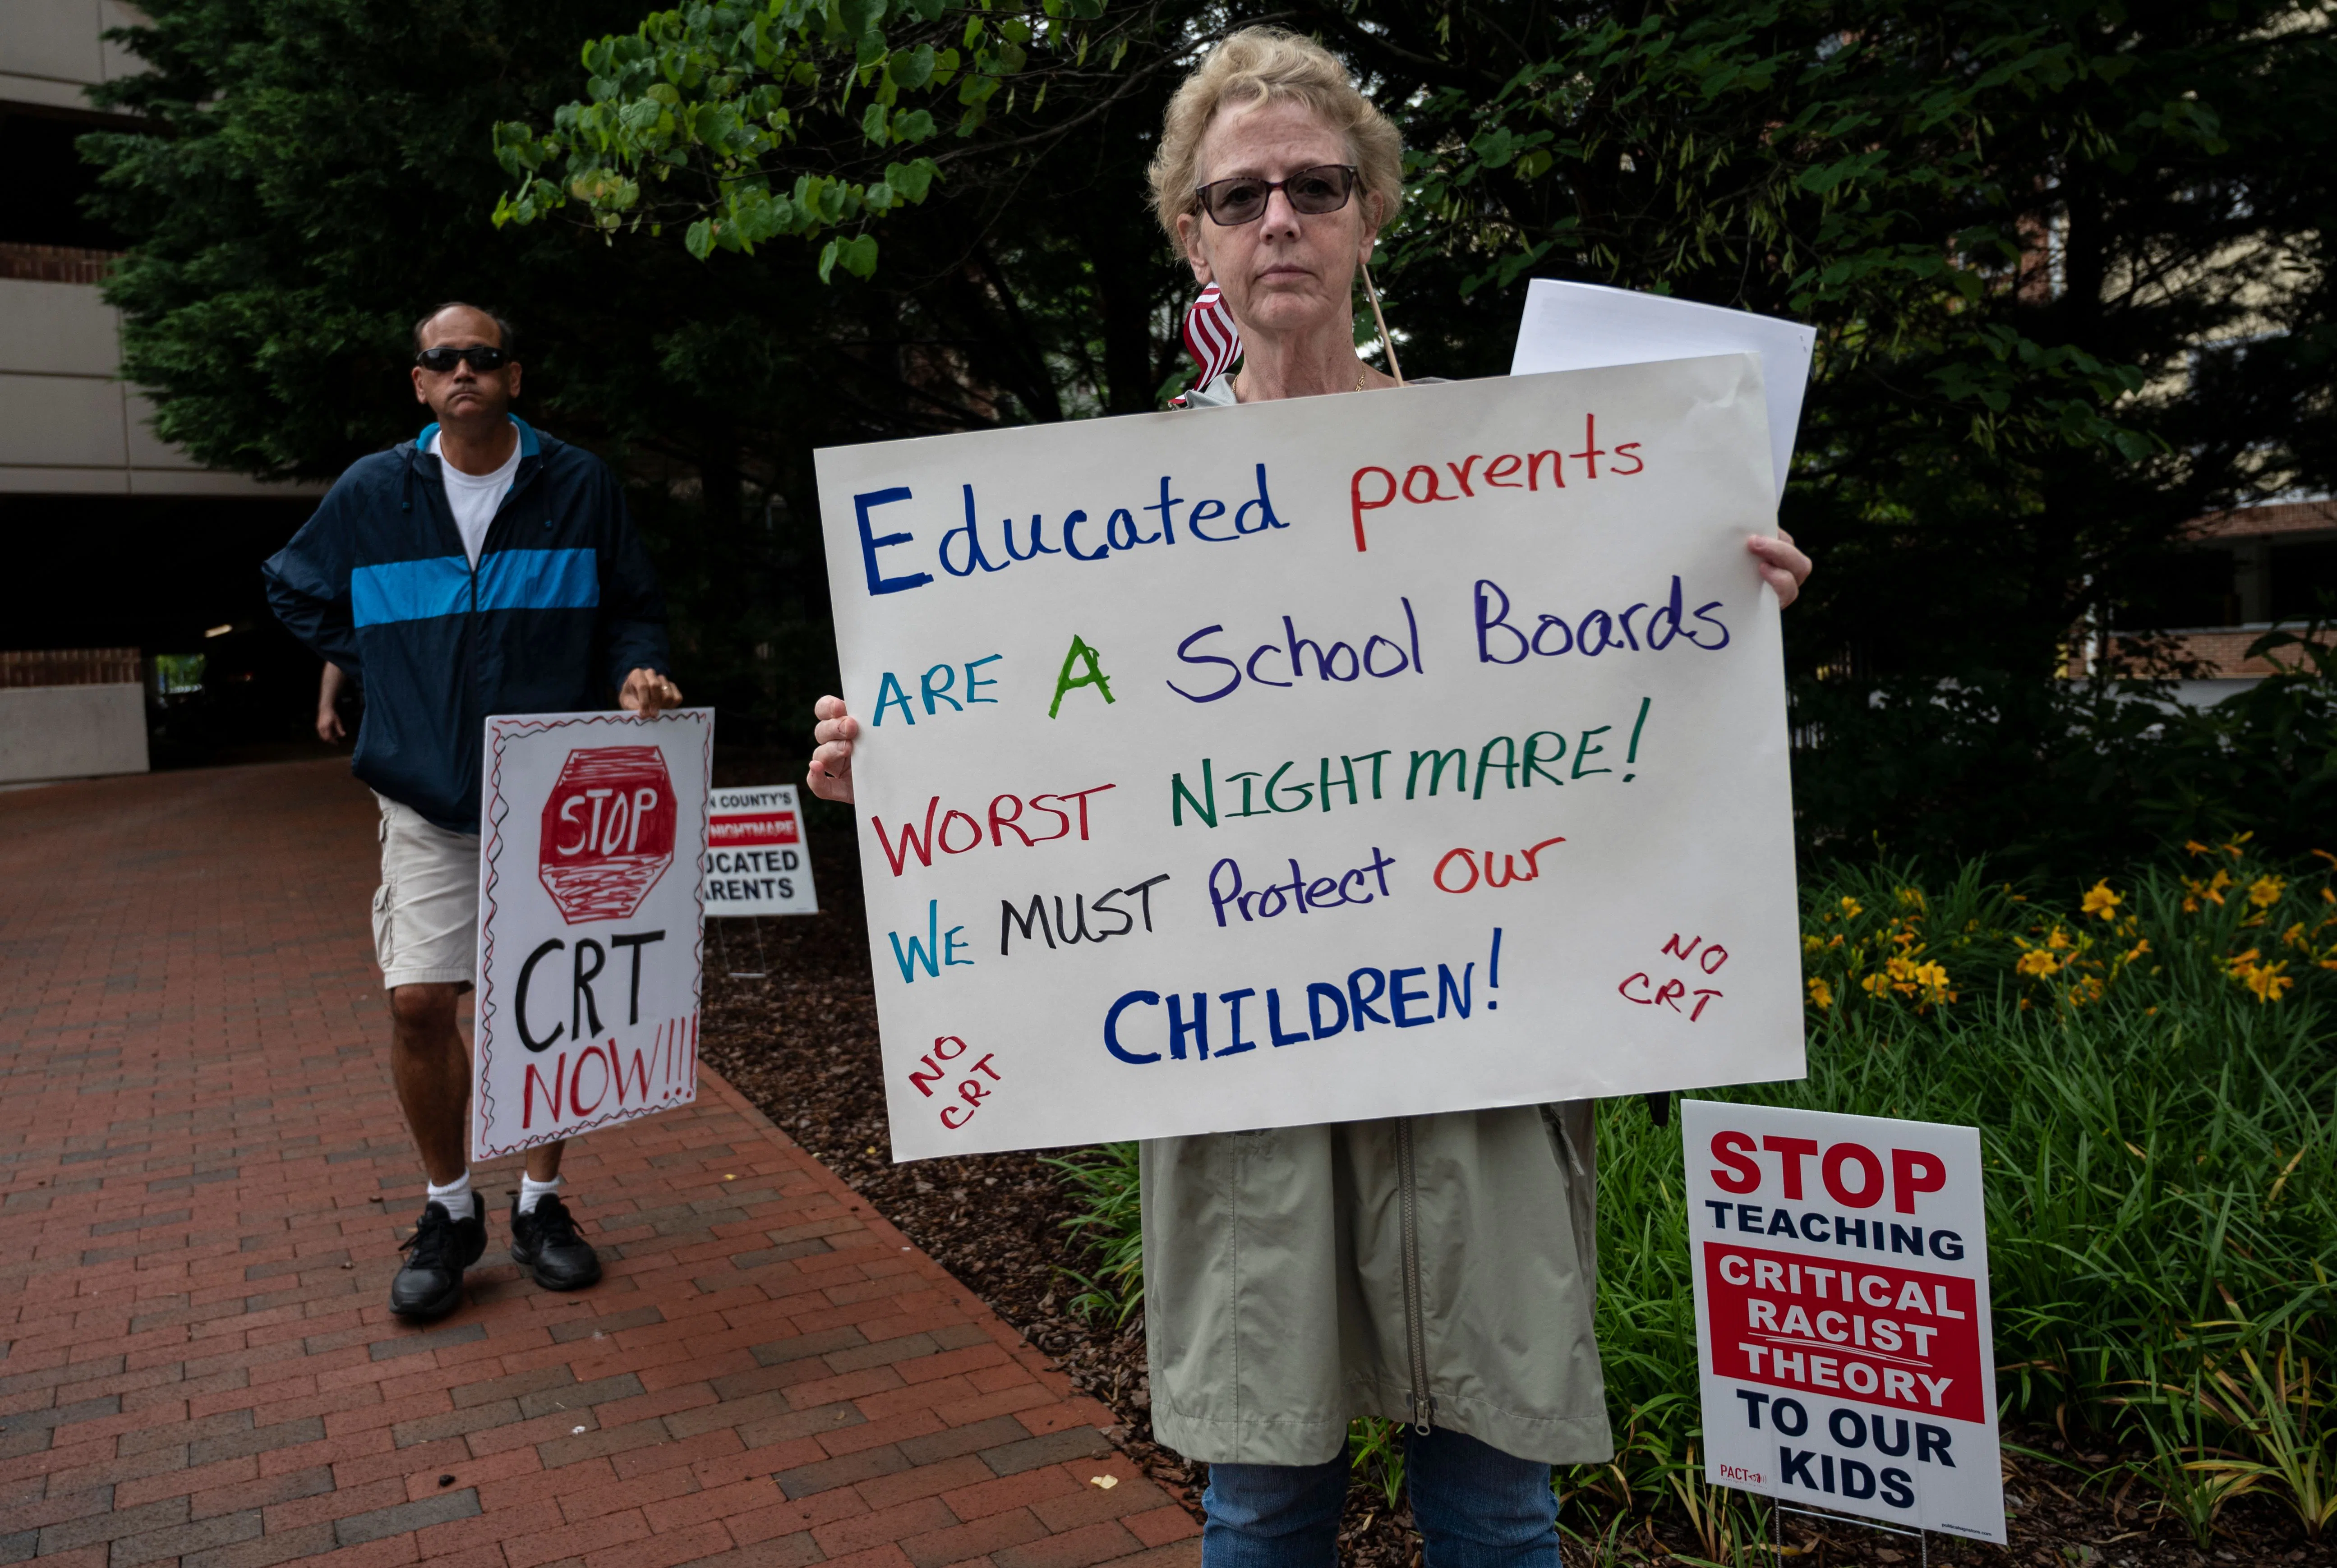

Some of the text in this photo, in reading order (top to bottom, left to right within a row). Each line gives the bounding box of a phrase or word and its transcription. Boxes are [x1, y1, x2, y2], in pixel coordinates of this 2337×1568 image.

[854, 413, 1644, 596] Educated parents
[872, 575, 1730, 727] ARE A School Boards
[721, 791, 792, 808] COUNTY'S
[871, 696, 1651, 877] WORST NIGHTMARE!
[557, 787, 658, 856] STOP
[888, 899, 975, 983] WE
[1000, 873, 1170, 956] MUST
[1208, 846, 1396, 927] Protect
[1661, 933, 1729, 975] NO
[515, 929, 666, 1053] CRT
[1103, 927, 1502, 1065] CHILDREN!
[1618, 972, 1723, 1022] CRT
[522, 1012, 697, 1129] NOW!!!
[908, 1036, 967, 1097] NO
[940, 1053, 1001, 1129] CRT
[1710, 1131, 1946, 1215] STOP
[1705, 1200, 1964, 1261] TEACHING
[1719, 1255, 1965, 1320] CRITICAL
[1747, 1298, 1938, 1357] RACIST
[1738, 1342, 1954, 1407] THEORY
[1736, 1388, 1956, 1468] TO OUR
[1720, 1464, 1749, 1481] PACT
[1779, 1445, 1915, 1508] KIDS
